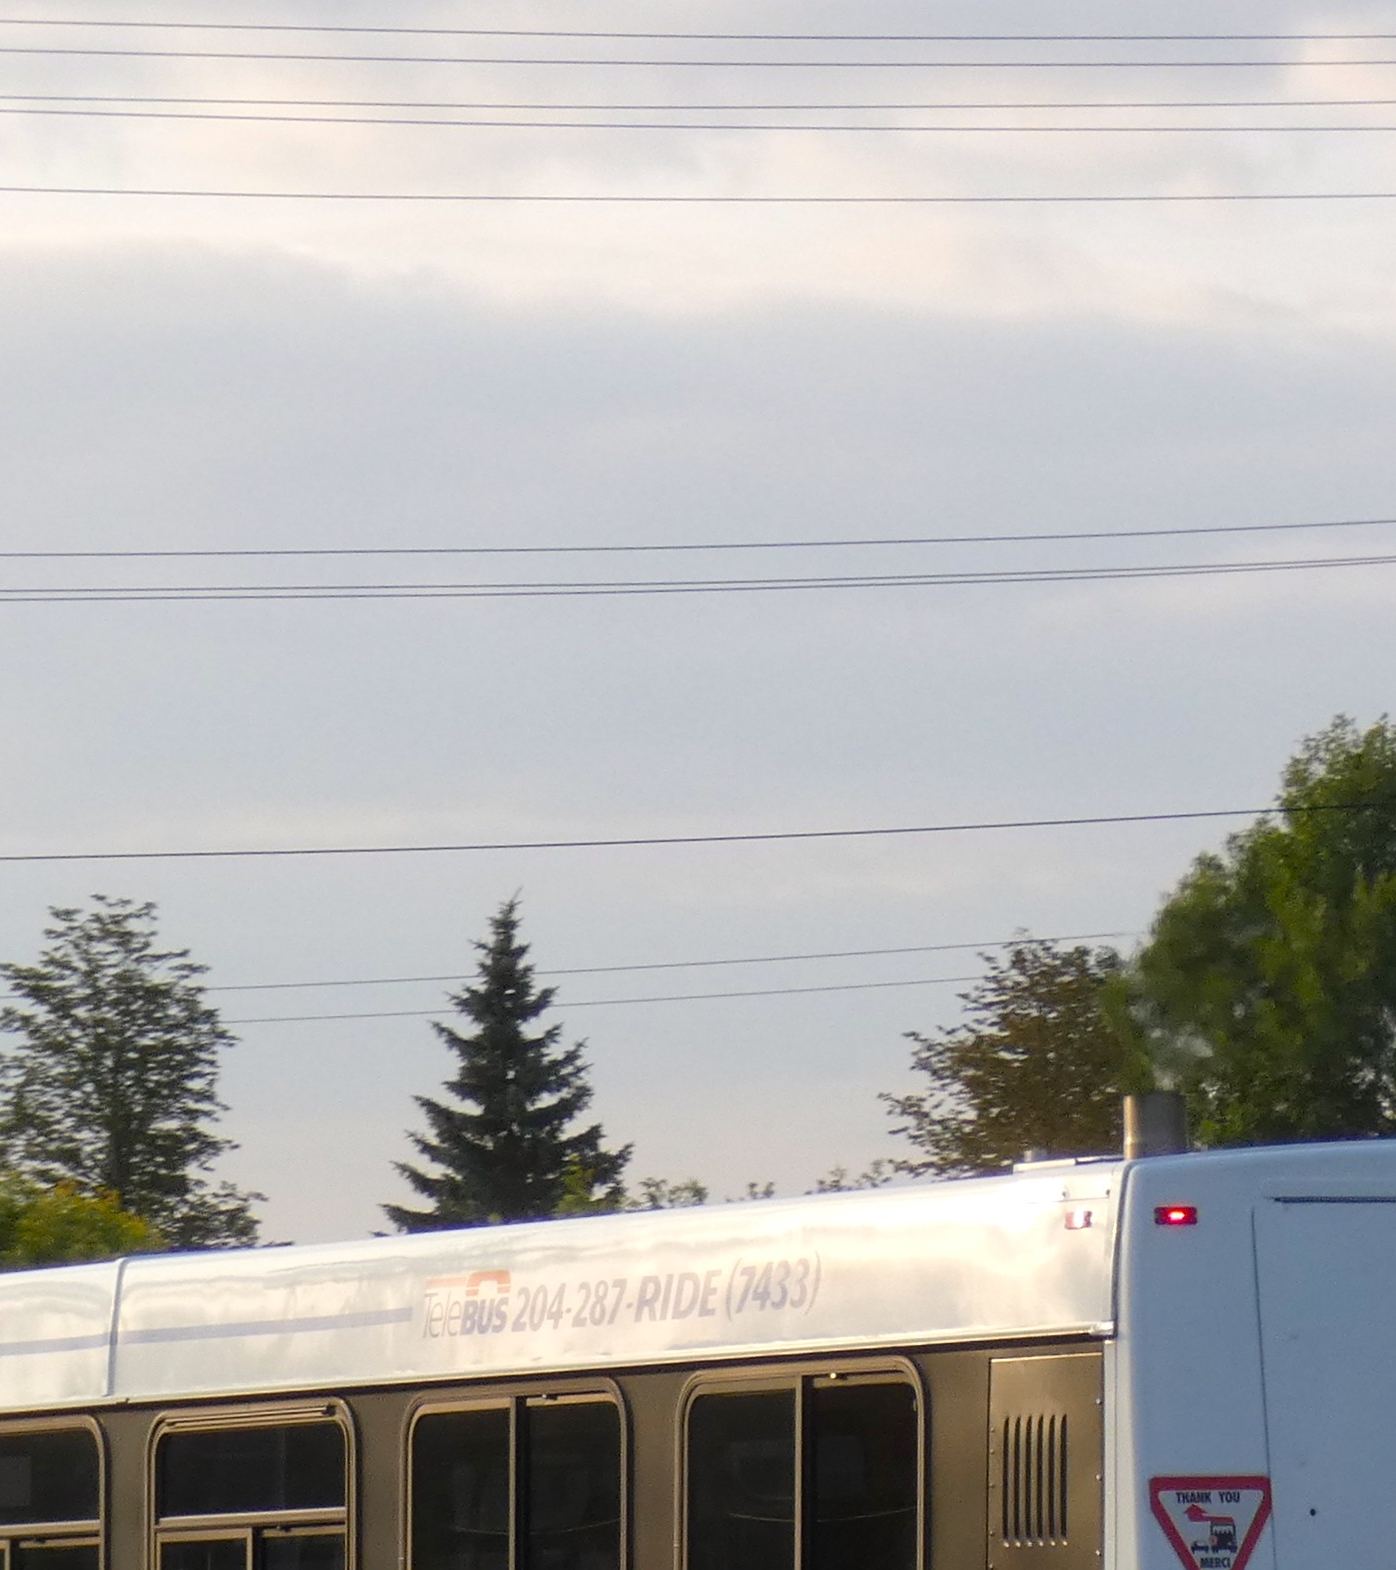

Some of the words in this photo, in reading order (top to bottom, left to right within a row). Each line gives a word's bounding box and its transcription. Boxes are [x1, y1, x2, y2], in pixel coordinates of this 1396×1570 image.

[422, 1288, 509, 1338] TeleBUS
[511, 1269, 722, 1332] 204-287-RIDE
[724, 1251, 822, 1322] (7433)
[1176, 1491, 1212, 1504] THANK
[1218, 1491, 1240, 1503] YOU
[1200, 1557, 1231, 1568] MERCI
